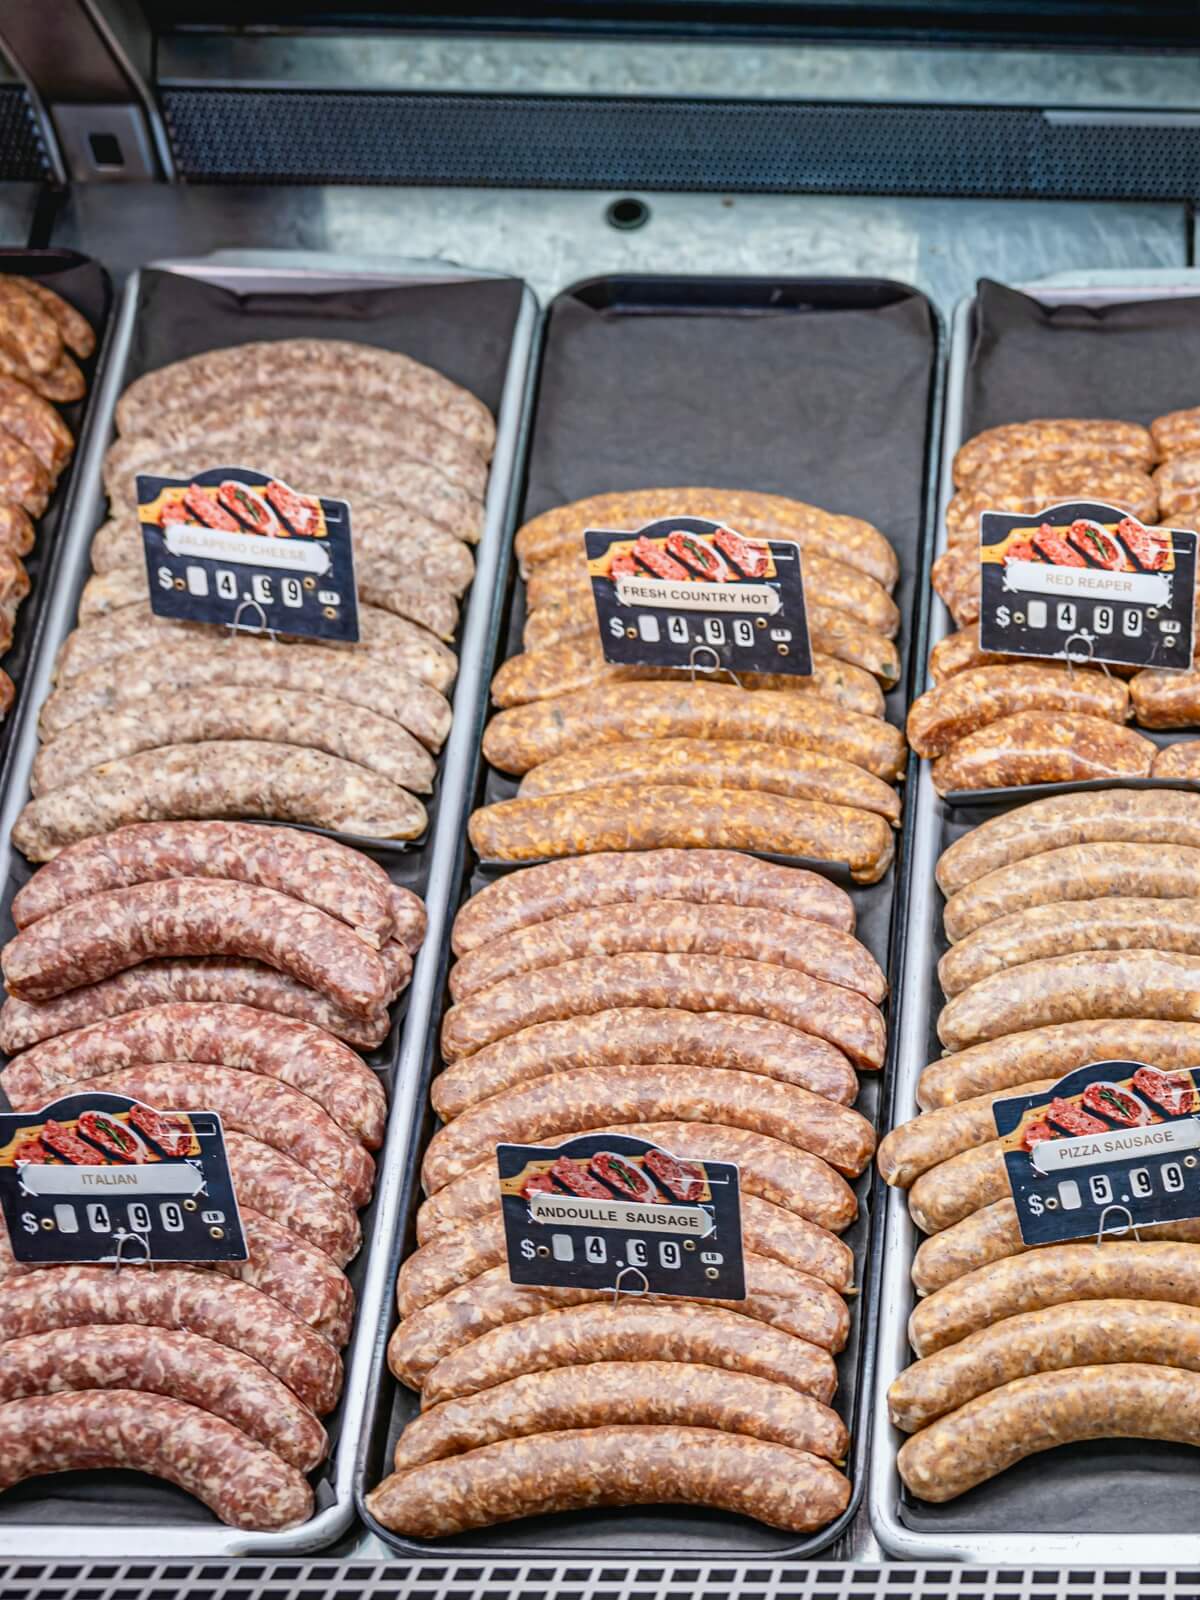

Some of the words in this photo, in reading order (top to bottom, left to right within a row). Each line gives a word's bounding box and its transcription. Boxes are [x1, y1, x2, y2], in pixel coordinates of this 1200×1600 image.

[250, 543, 305, 561] CHEESE
[1046, 574, 1074, 586] RED
[1078, 578, 1133, 592] REAPER
[623, 586, 666, 599] FRESH
[671, 590, 735, 604] COUNTRY
[742, 594, 768, 604] HOT
[1059, 1144, 1101, 1159] PIZZA
[1104, 1130, 1174, 1152] SAUSAGE
[81, 1174, 138, 1185] ITALIAN
[536, 1207, 618, 1222] ANDOULLE
[626, 1212, 699, 1228] SAUSAGE
[706, 1253, 717, 1261] LB
